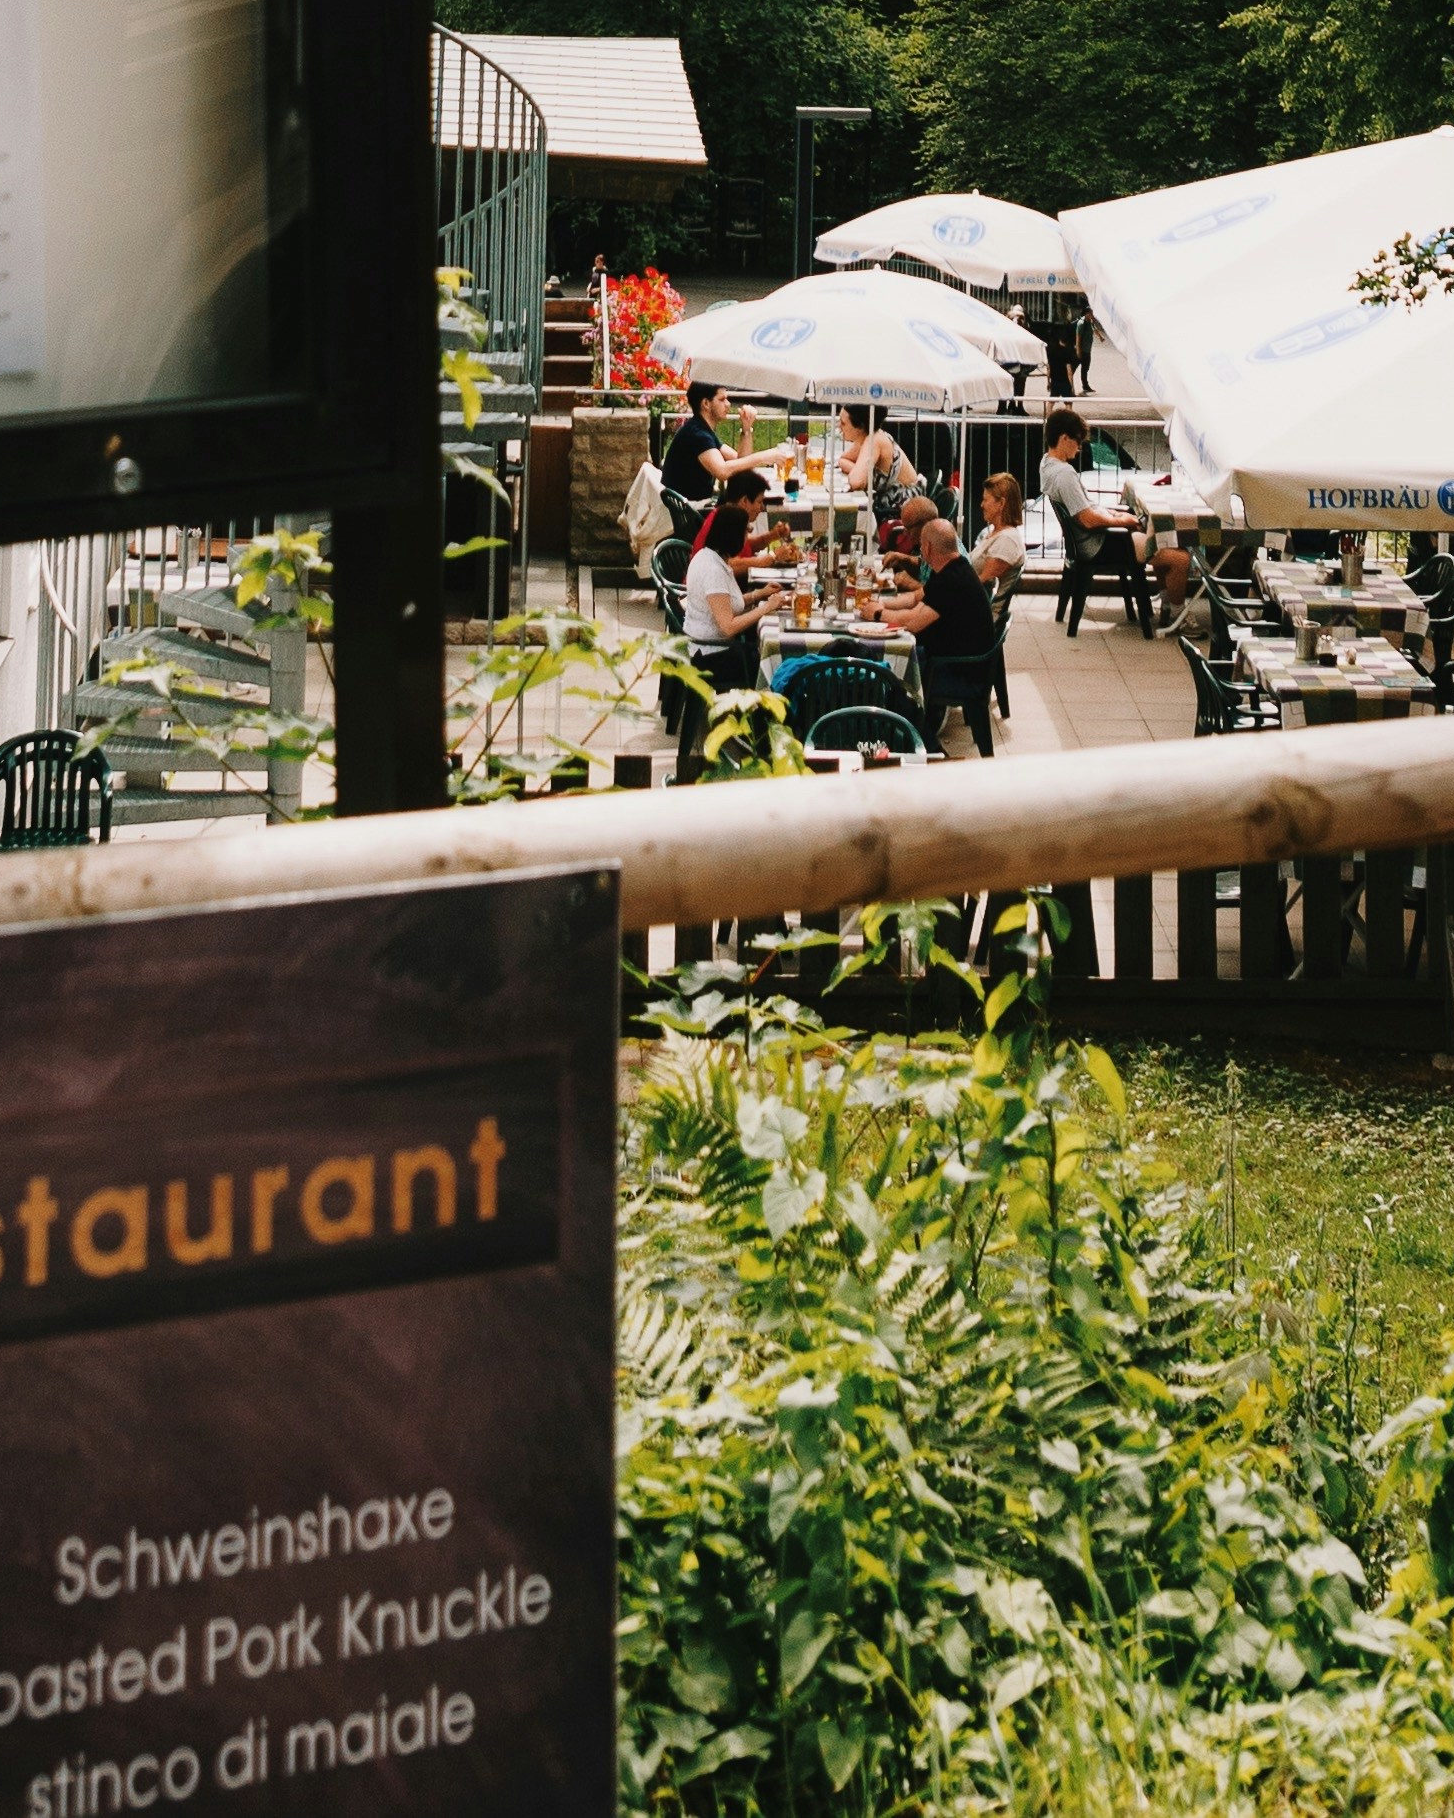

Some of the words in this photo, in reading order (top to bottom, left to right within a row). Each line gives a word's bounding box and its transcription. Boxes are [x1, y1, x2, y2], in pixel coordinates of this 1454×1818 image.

[1307, 485, 1430, 509] HOFBRÄU
[56, 1487, 456, 1606] Schweinshaxe
[203, 1603, 324, 1685] Pork
[339, 1566, 553, 1659] Knuckle
[26, 1750, 201, 1818] stinco
[217, 1718, 270, 1790] di
[286, 1685, 477, 1775] maiale
